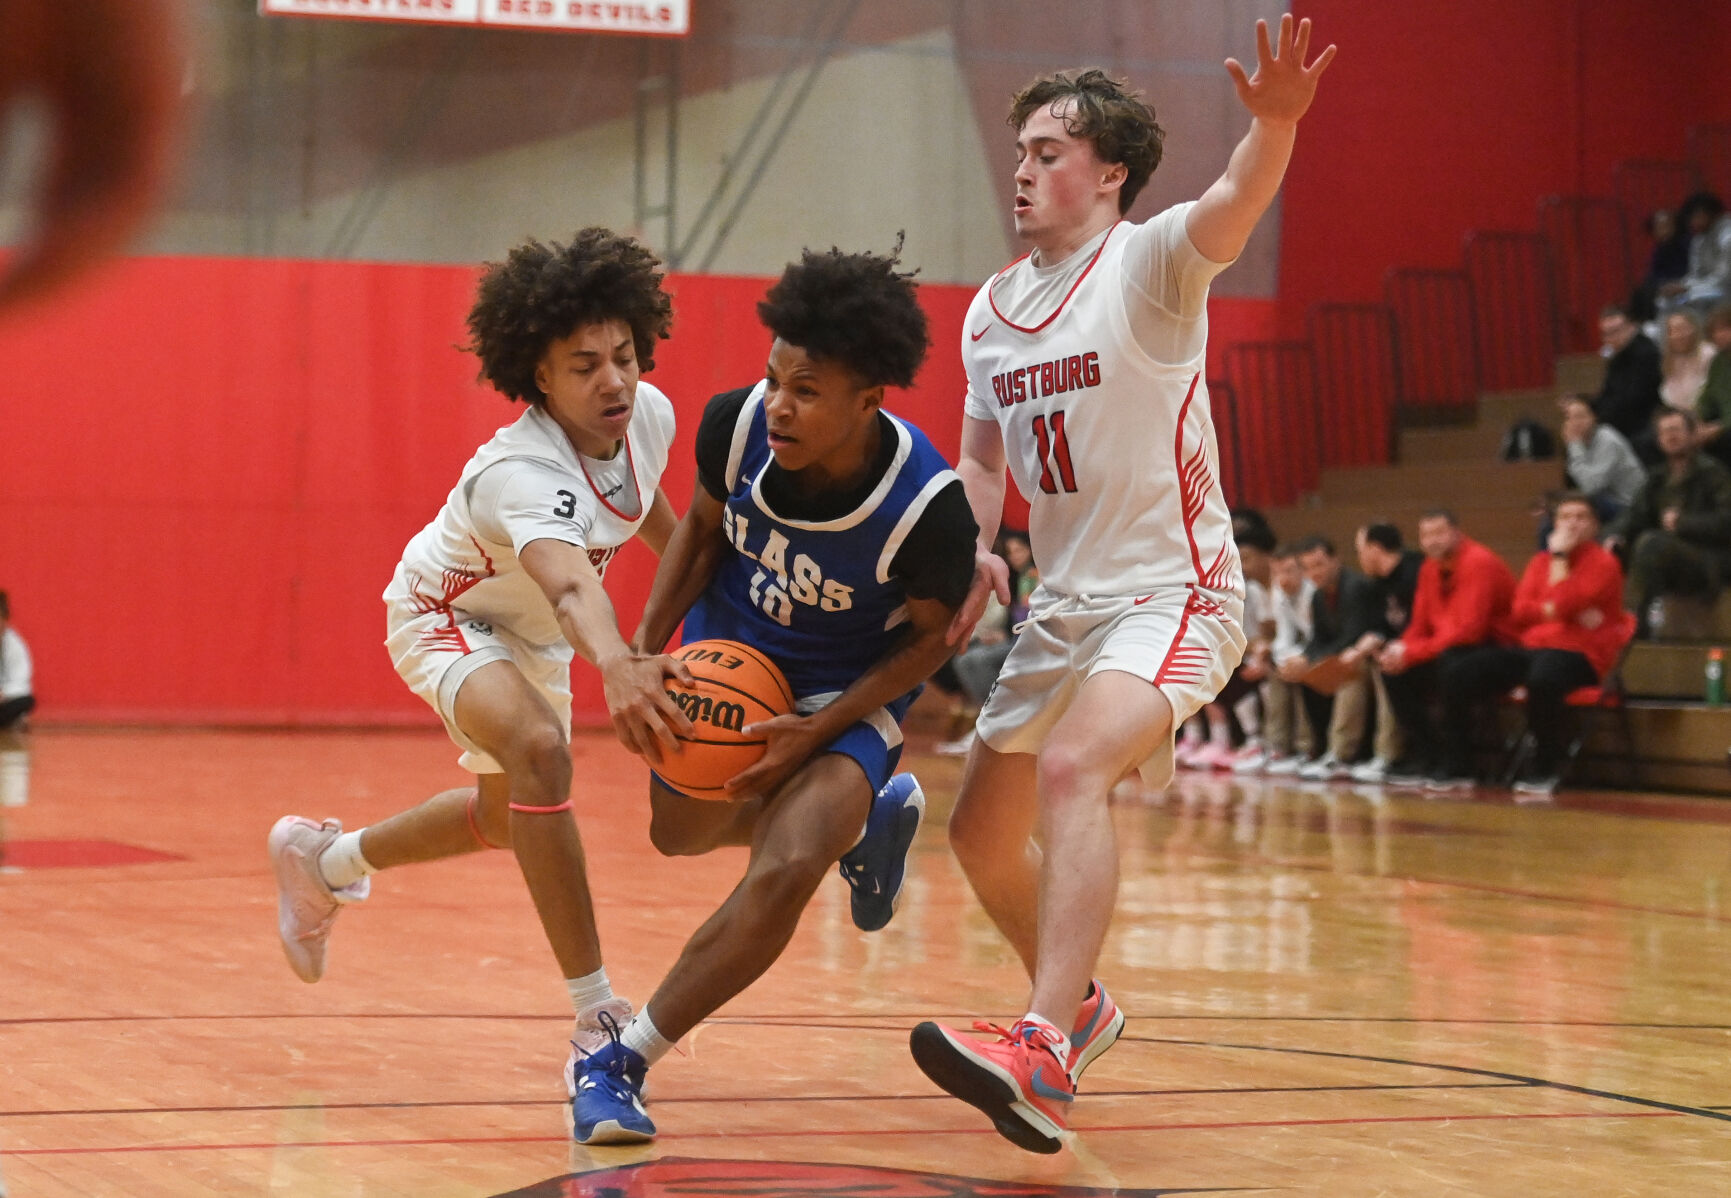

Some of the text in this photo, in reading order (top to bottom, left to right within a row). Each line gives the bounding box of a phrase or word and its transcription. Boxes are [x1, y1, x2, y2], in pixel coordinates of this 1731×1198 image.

[568, 1, 672, 22] DEVILS
[992, 351, 1101, 409] RUSTBURG
[1032, 410, 1079, 495] 11
[553, 489, 577, 519] 3
[749, 565, 794, 627] 10
[667, 689, 746, 733] Wils
